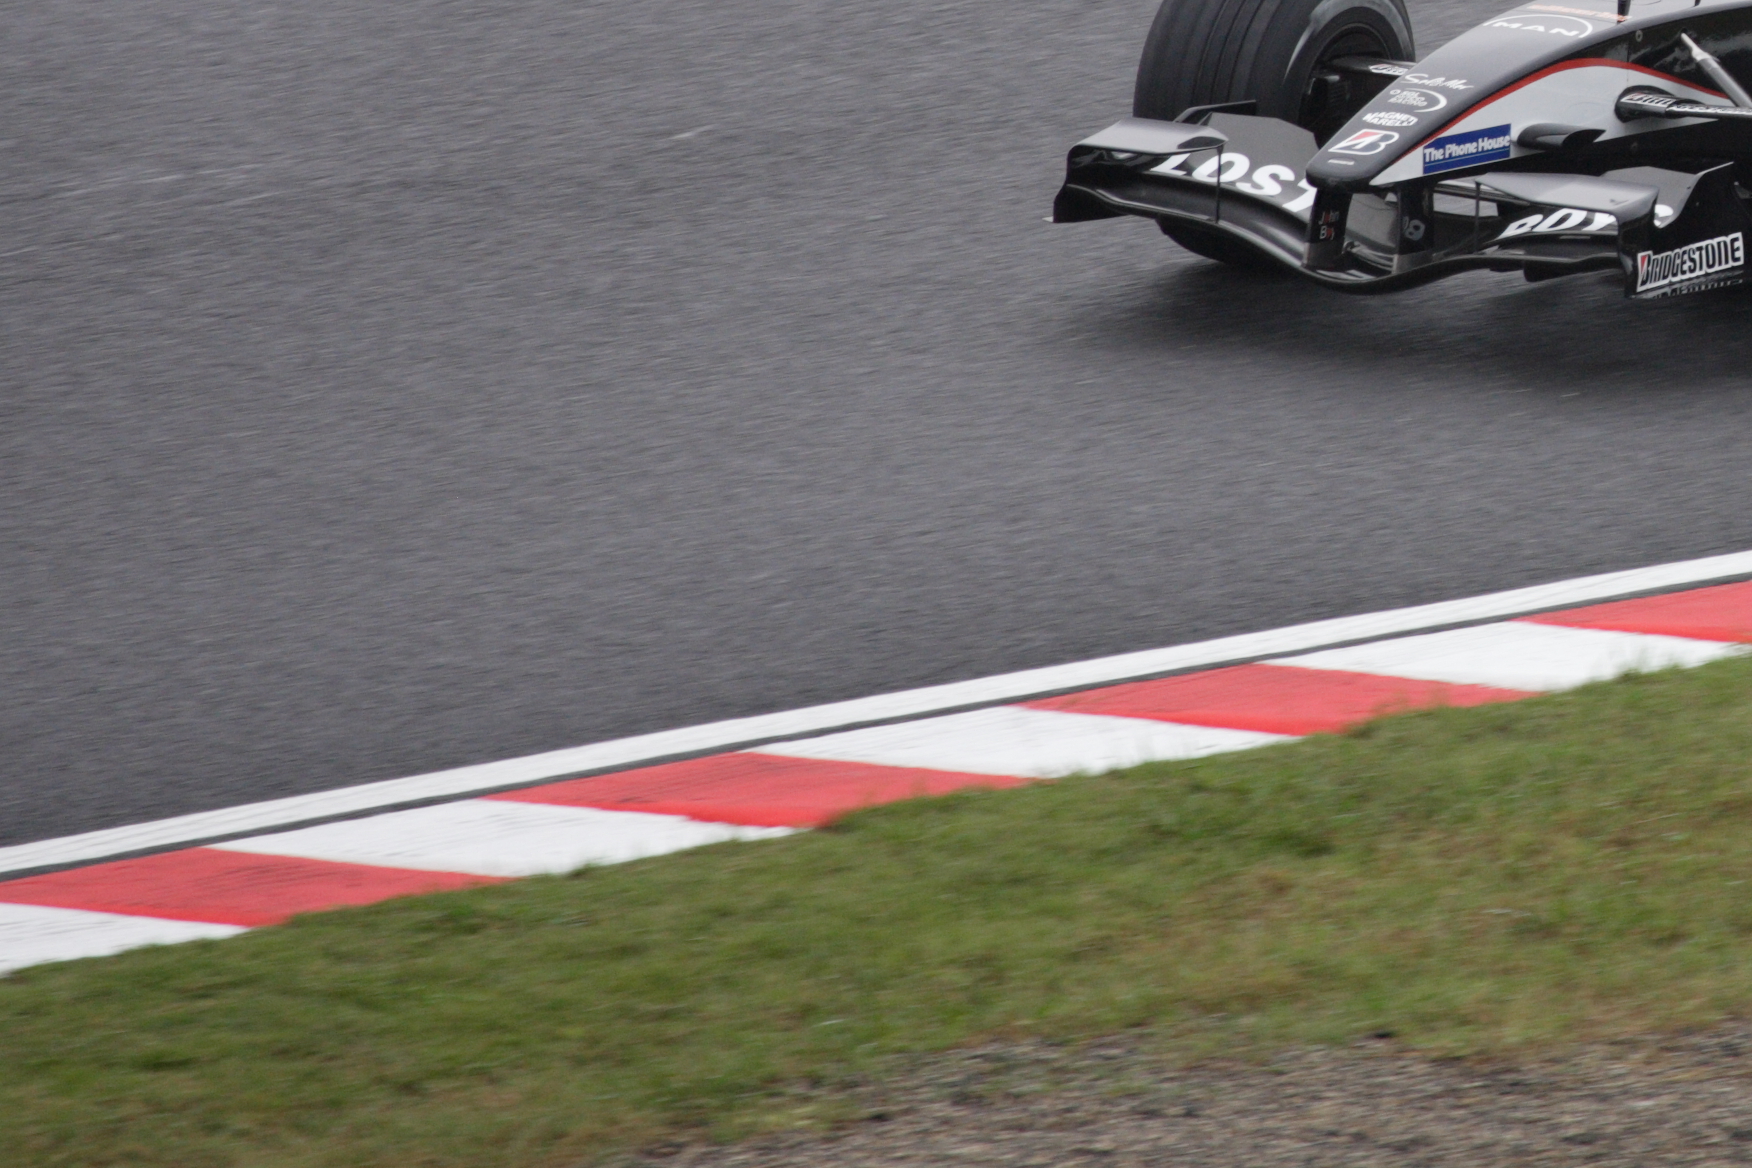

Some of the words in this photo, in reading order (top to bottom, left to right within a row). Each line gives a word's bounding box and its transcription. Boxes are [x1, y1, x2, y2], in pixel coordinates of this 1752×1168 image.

[1492, 21, 1581, 37] MAN
[1423, 147, 1444, 163] The
[1445, 141, 1477, 159] Phone
[1478, 135, 1511, 152] House
[1640, 235, 1742, 287] BRIDGESTONE
